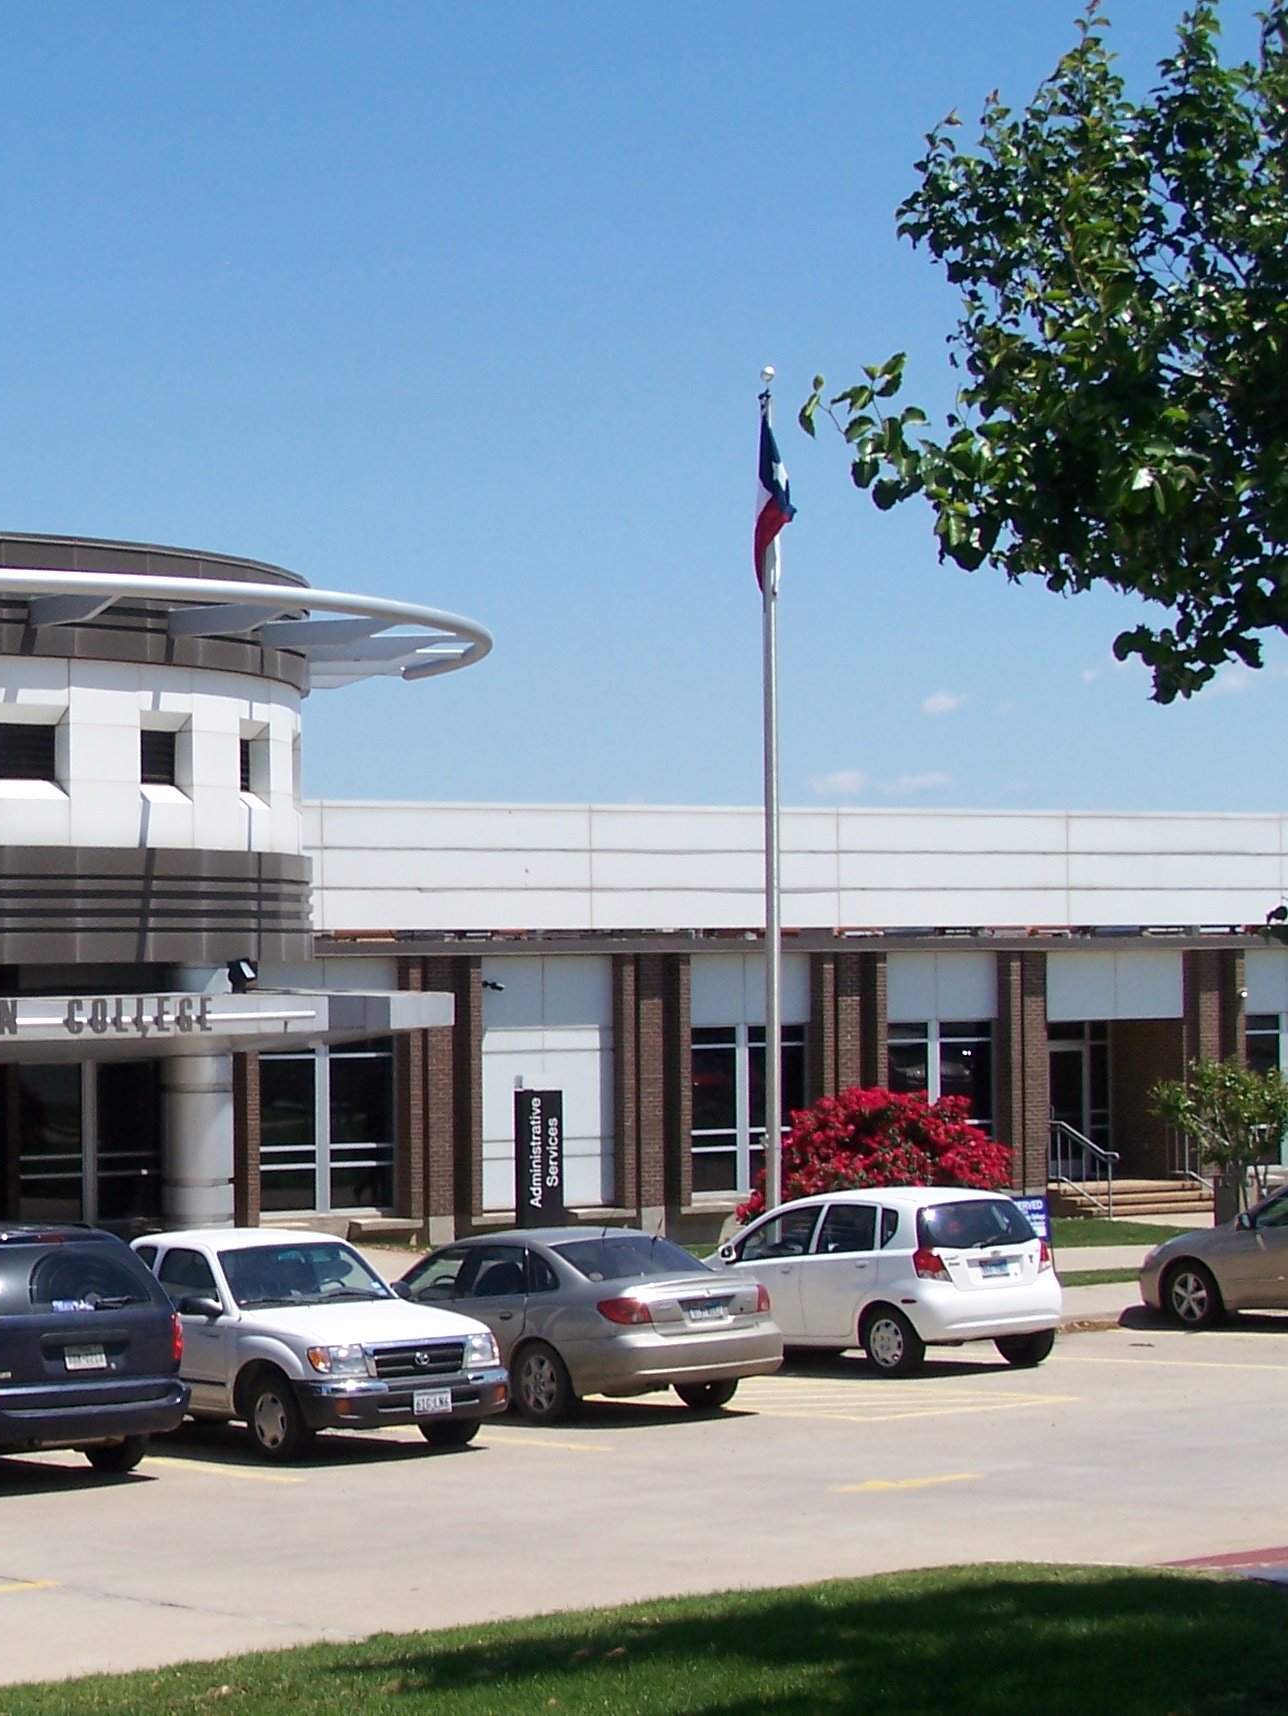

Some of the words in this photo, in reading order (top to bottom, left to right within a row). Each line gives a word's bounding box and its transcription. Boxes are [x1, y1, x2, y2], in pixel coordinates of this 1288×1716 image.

[63, 996, 214, 1034] COLLEGE
[528, 1096, 543, 1208] Administrative
[546, 1117, 560, 1187] Services
[1014, 1200, 1043, 1211] ERVED
